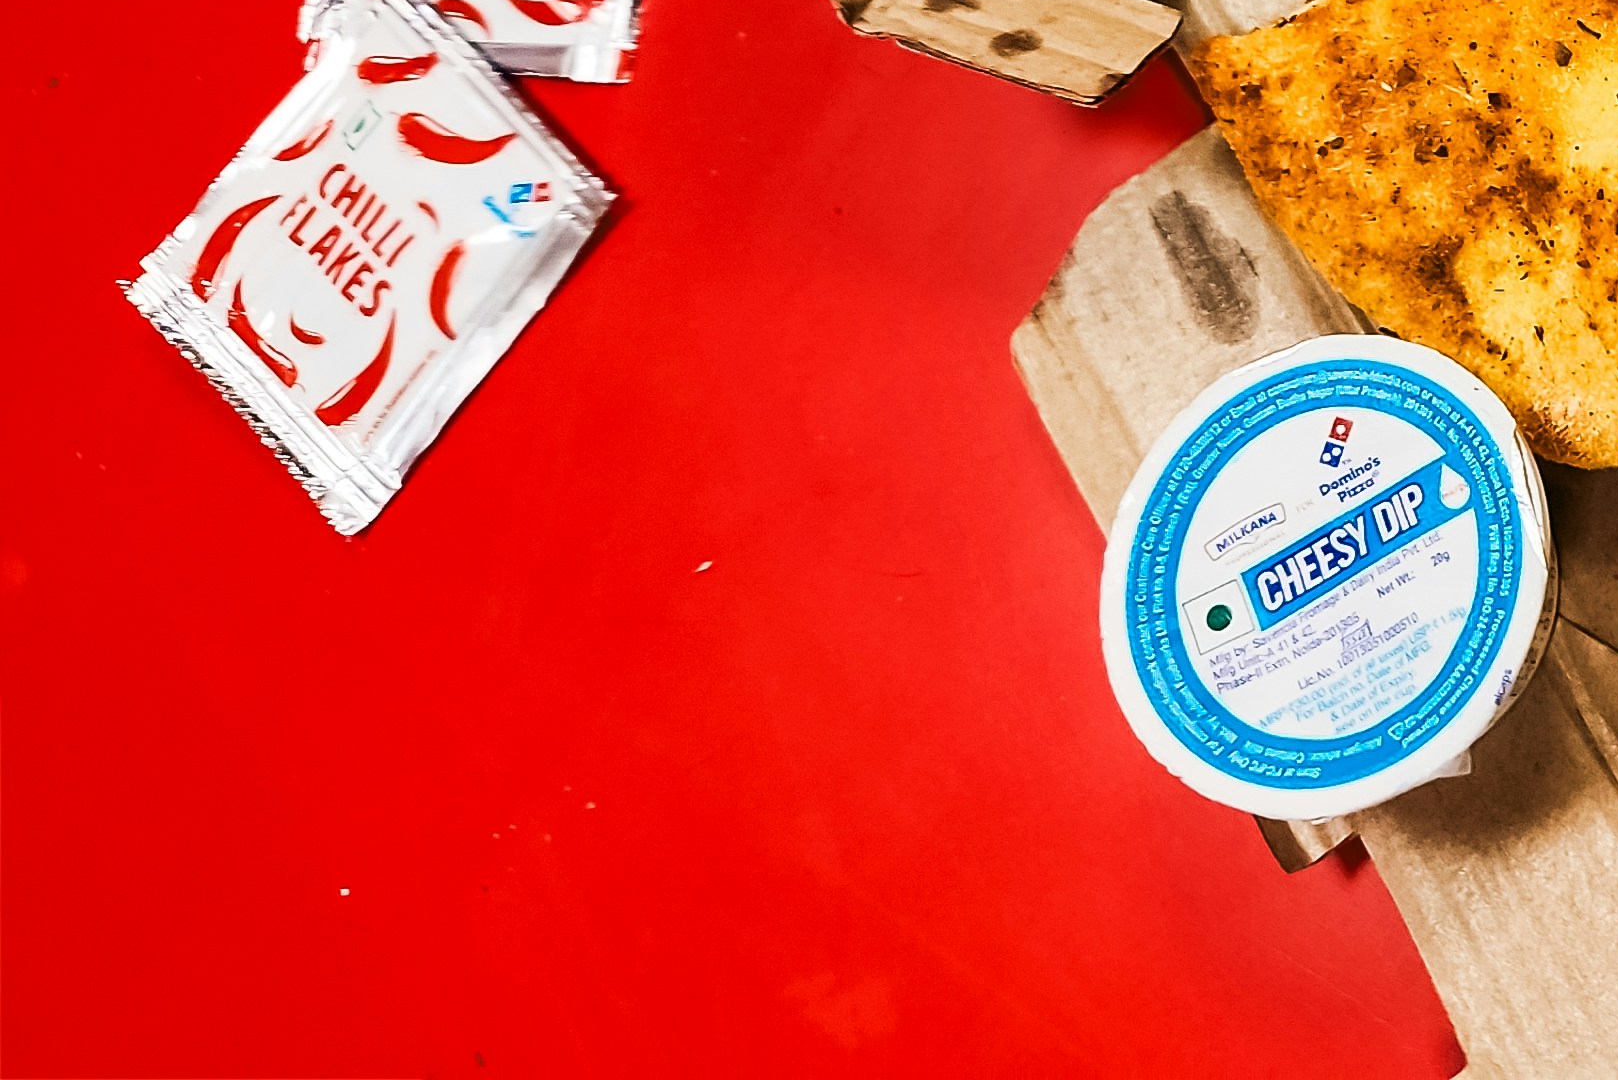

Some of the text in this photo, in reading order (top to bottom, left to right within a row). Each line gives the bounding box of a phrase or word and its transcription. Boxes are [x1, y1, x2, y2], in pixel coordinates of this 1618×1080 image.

[319, 163, 415, 267] CHILLI
[279, 194, 392, 317] FLAKES
[1318, 456, 1381, 497] Domino's
[1215, 511, 1277, 553] MILKANA
[1257, 484, 1423, 611] CHEESY DIP
[1430, 548, 1450, 567] 20g
